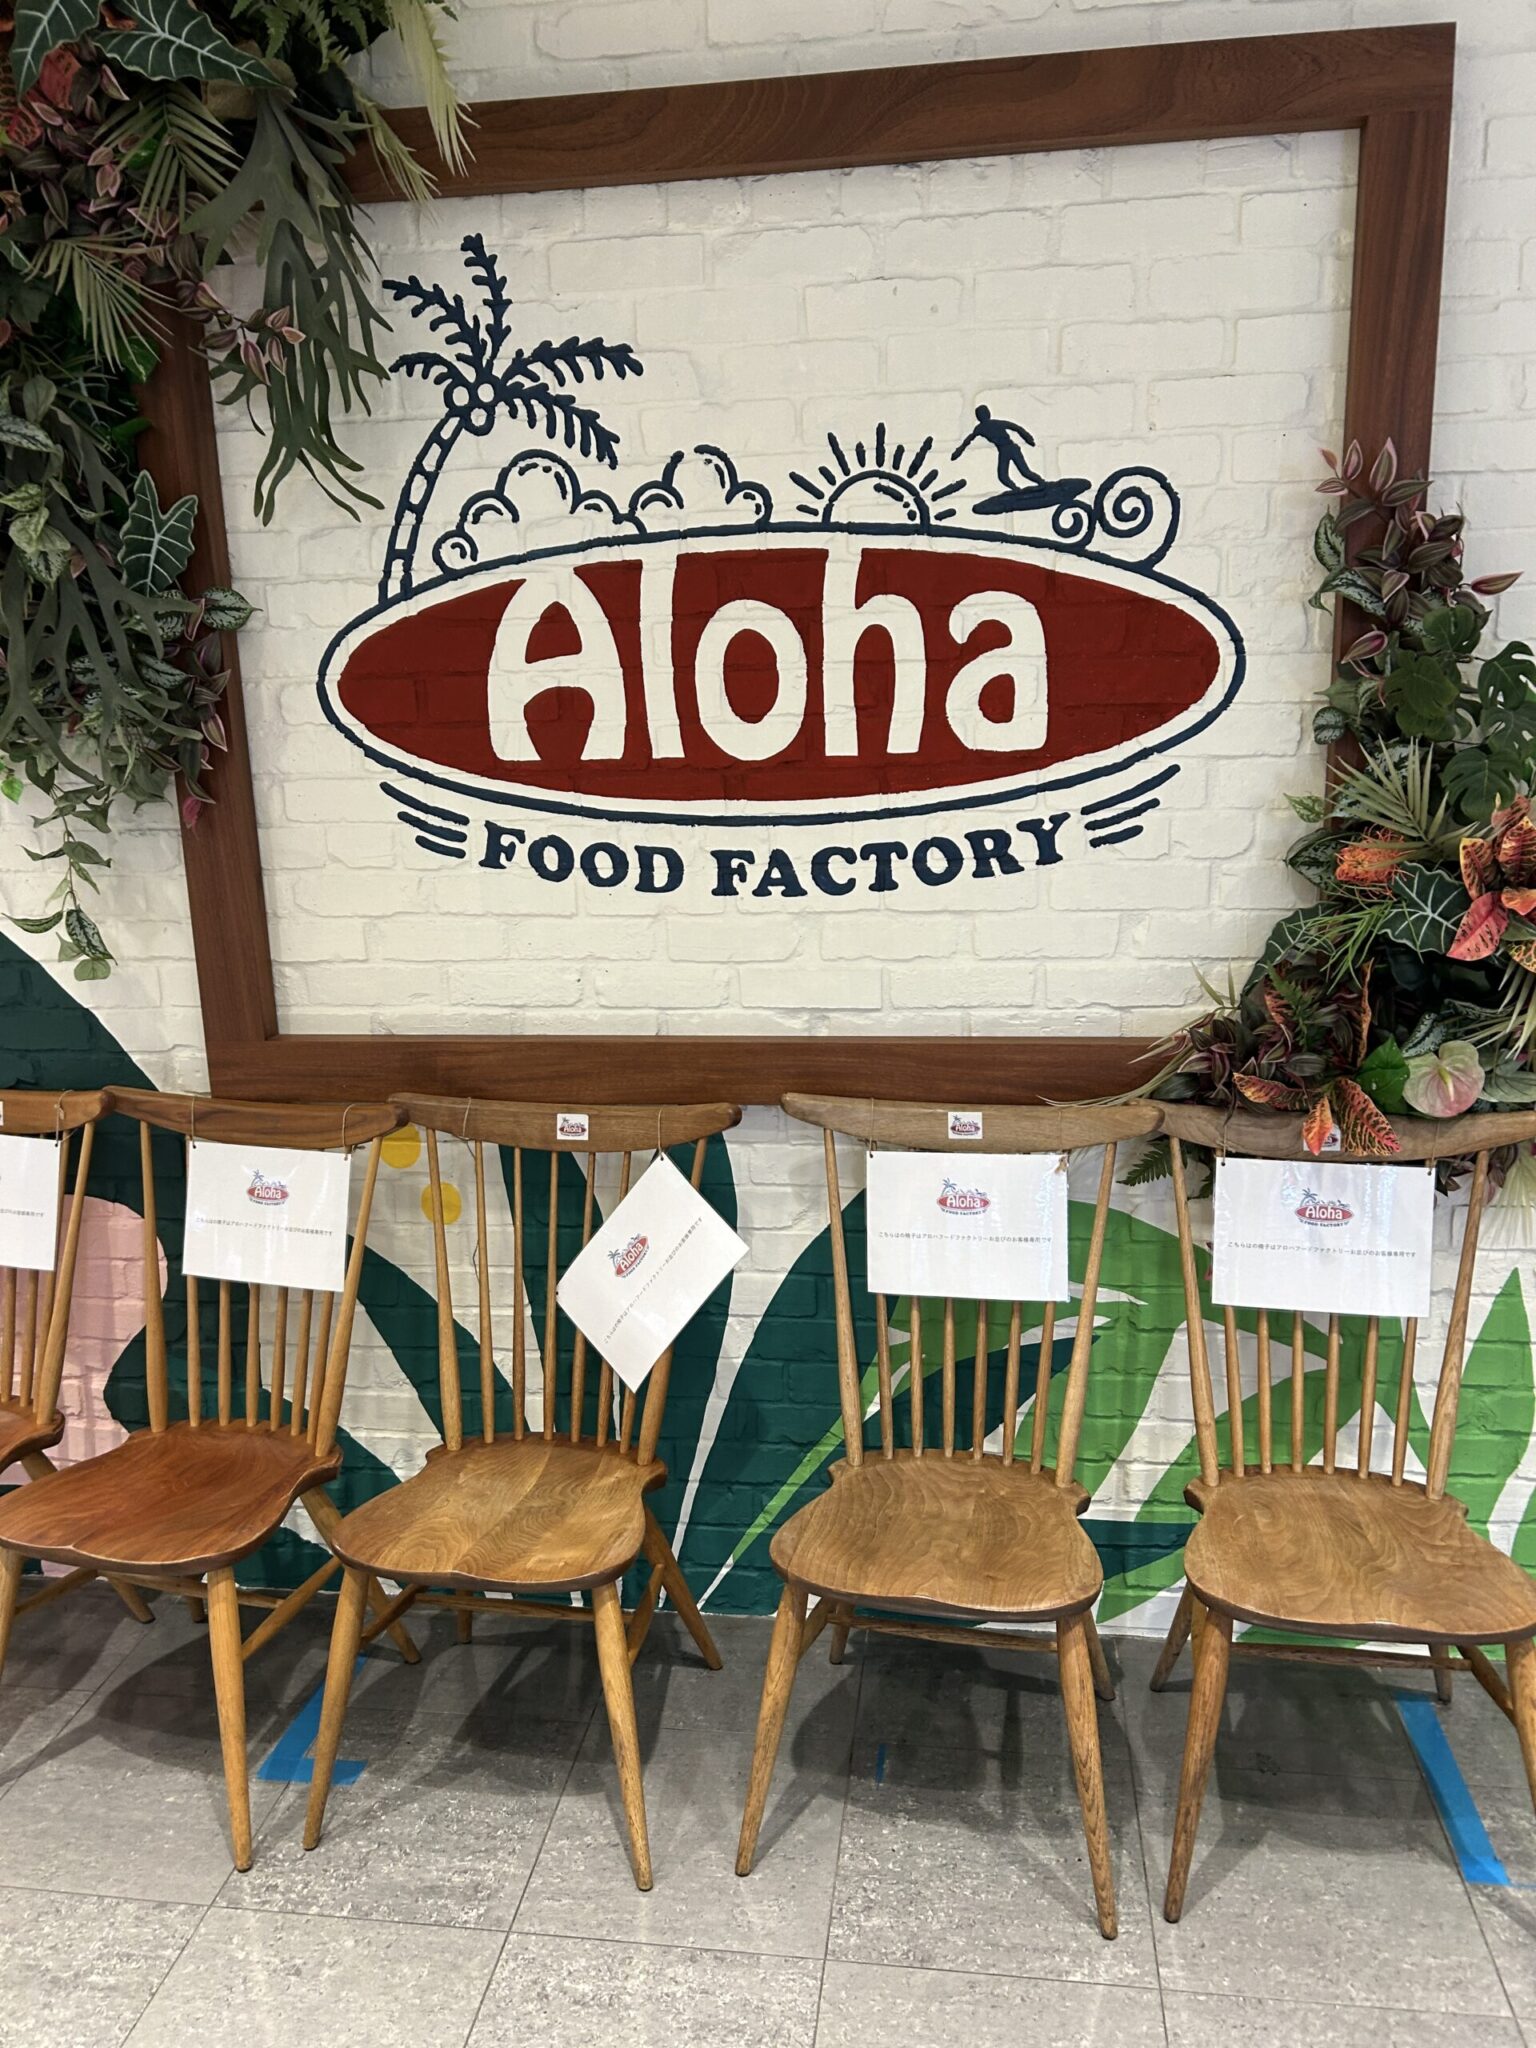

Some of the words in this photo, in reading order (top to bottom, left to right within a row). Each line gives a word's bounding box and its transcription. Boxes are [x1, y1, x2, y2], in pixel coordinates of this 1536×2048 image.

[487, 546, 1049, 762] Aloha
[481, 821, 684, 893] FOOD
[711, 812, 1071, 898] FACTORY
[254, 1186, 282, 1199] Aloha
[946, 1194, 981, 1208] Aloha
[1305, 1205, 1343, 1220] Aloha
[619, 1242, 643, 1271] Aloha
